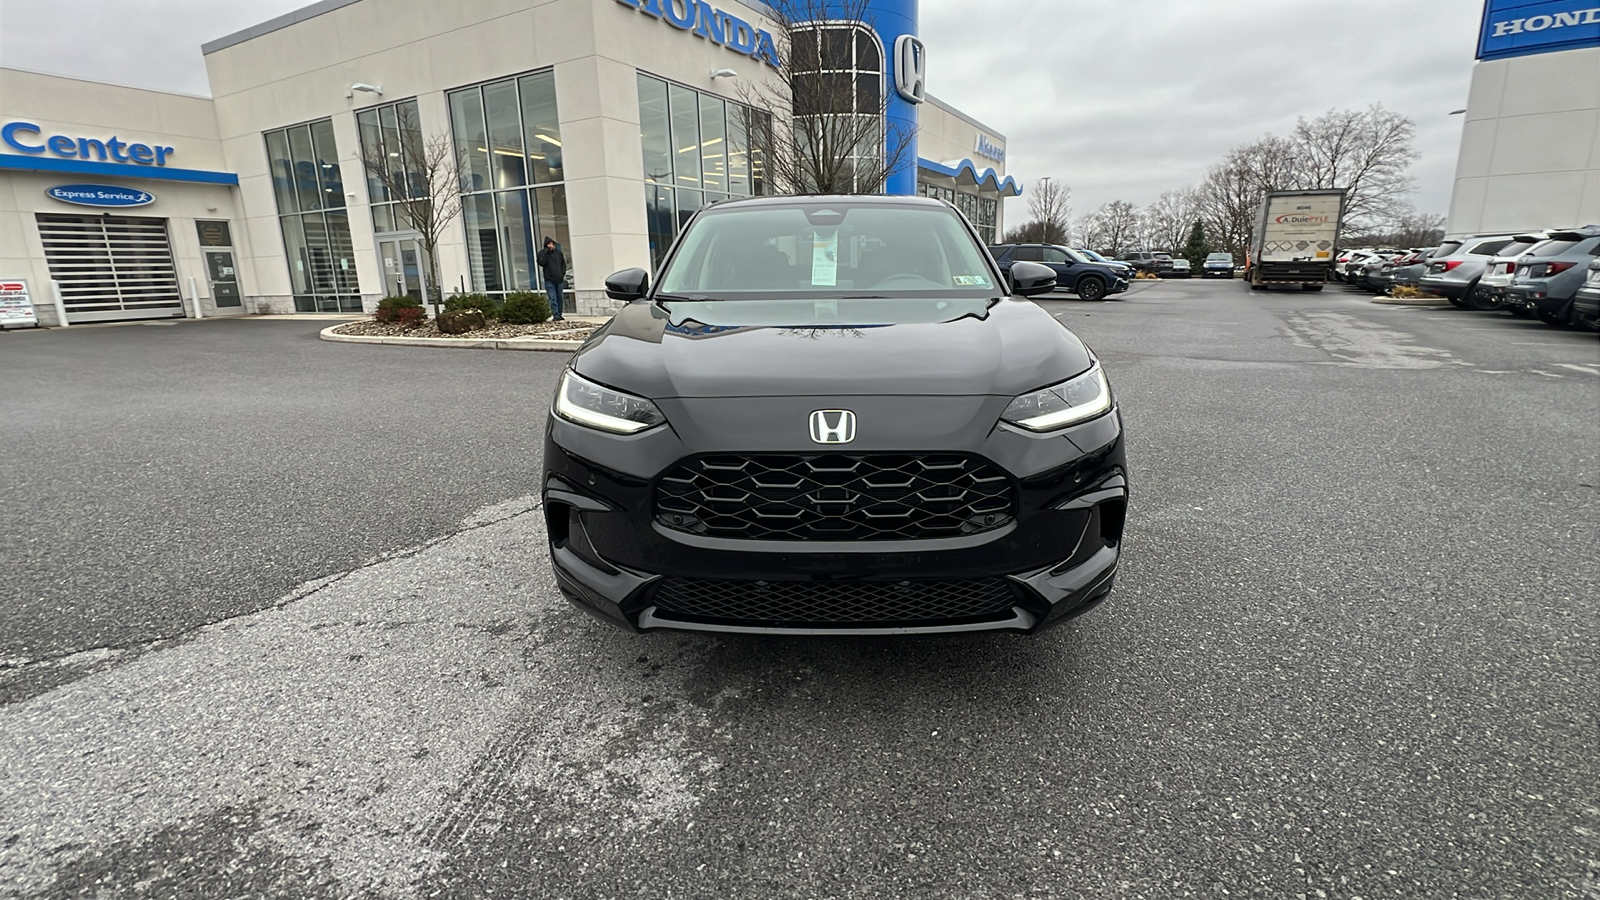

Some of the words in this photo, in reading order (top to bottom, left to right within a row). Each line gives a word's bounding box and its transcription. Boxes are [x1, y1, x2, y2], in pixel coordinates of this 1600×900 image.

[1, 121, 174, 166] Center
[54, 188, 96, 199] Express
[97, 191, 135, 200] Service
